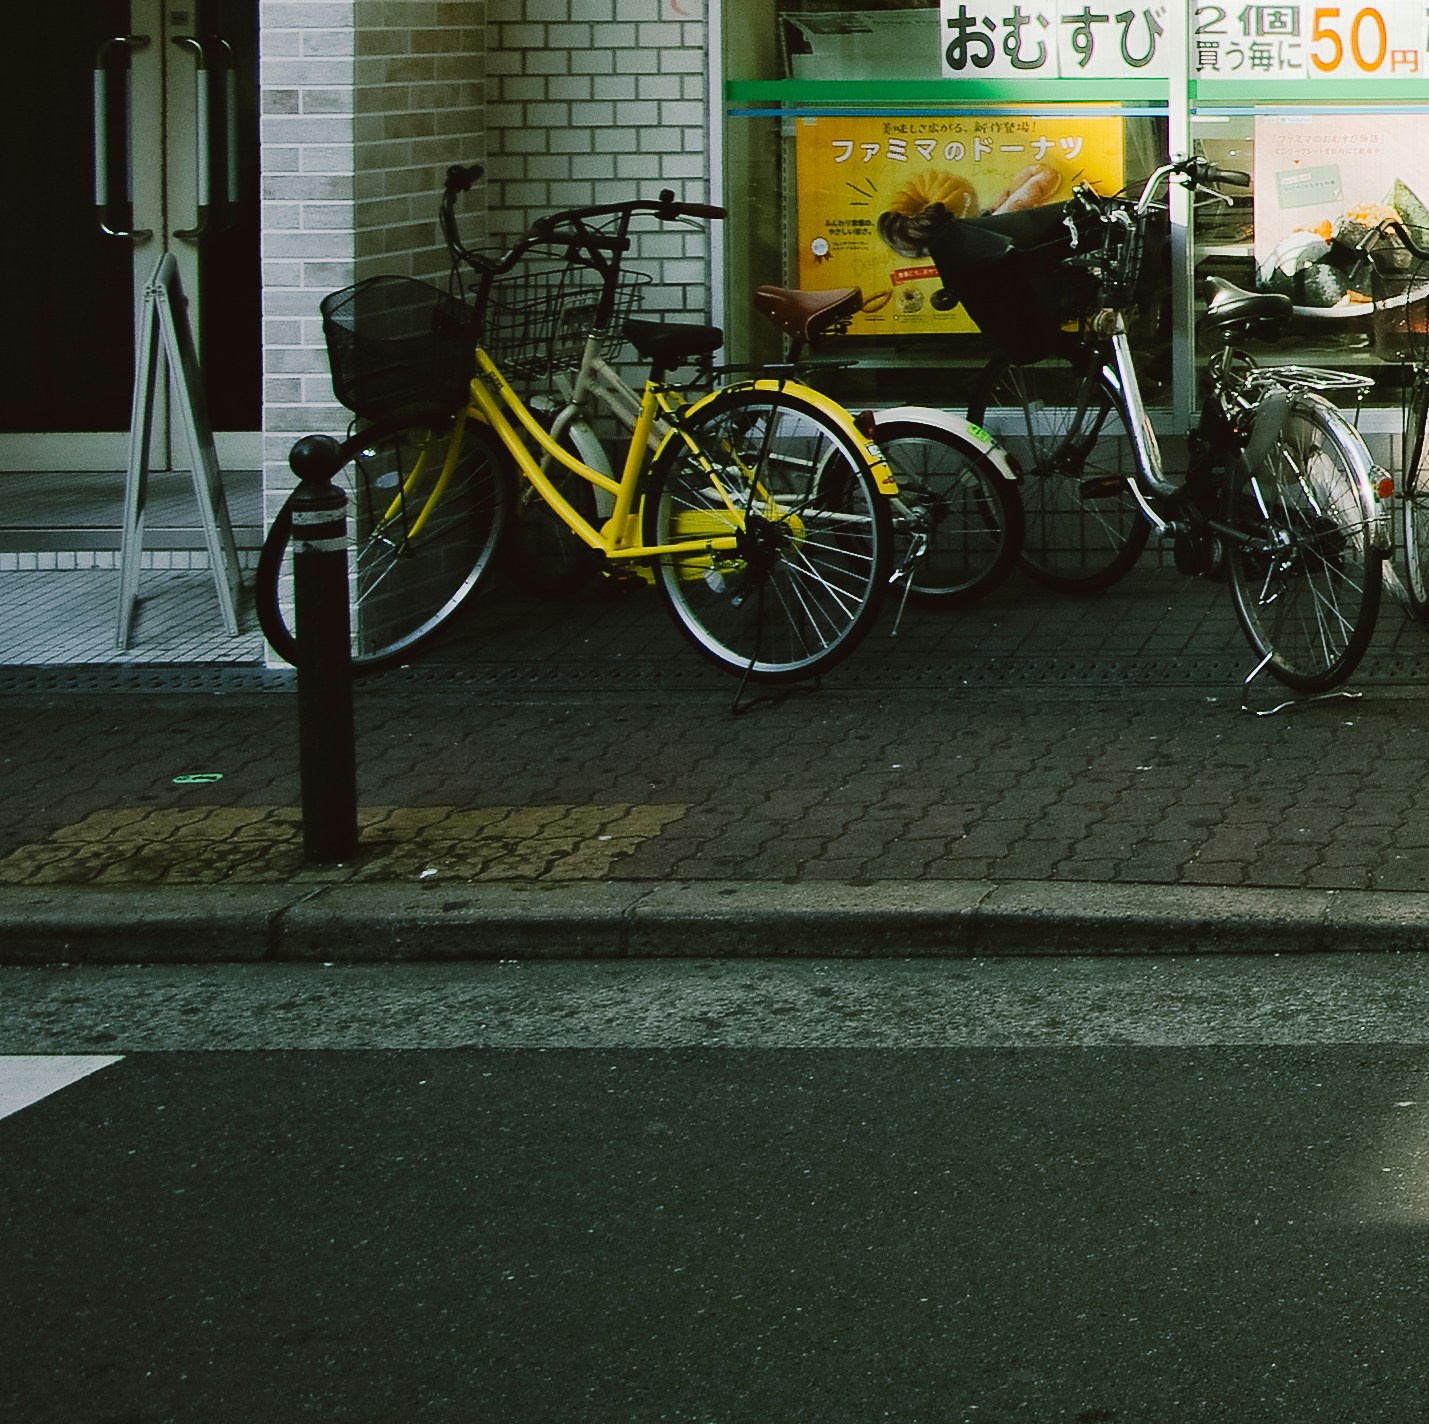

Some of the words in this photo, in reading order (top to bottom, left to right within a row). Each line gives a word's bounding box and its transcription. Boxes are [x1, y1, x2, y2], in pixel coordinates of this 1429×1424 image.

[1194, 4, 1300, 37] 2個
[945, 4, 1167, 71] おむすび
[1195, 40, 1303, 72] 買う毎に
[831, 136, 1084, 163] ファミマのドーナツ
